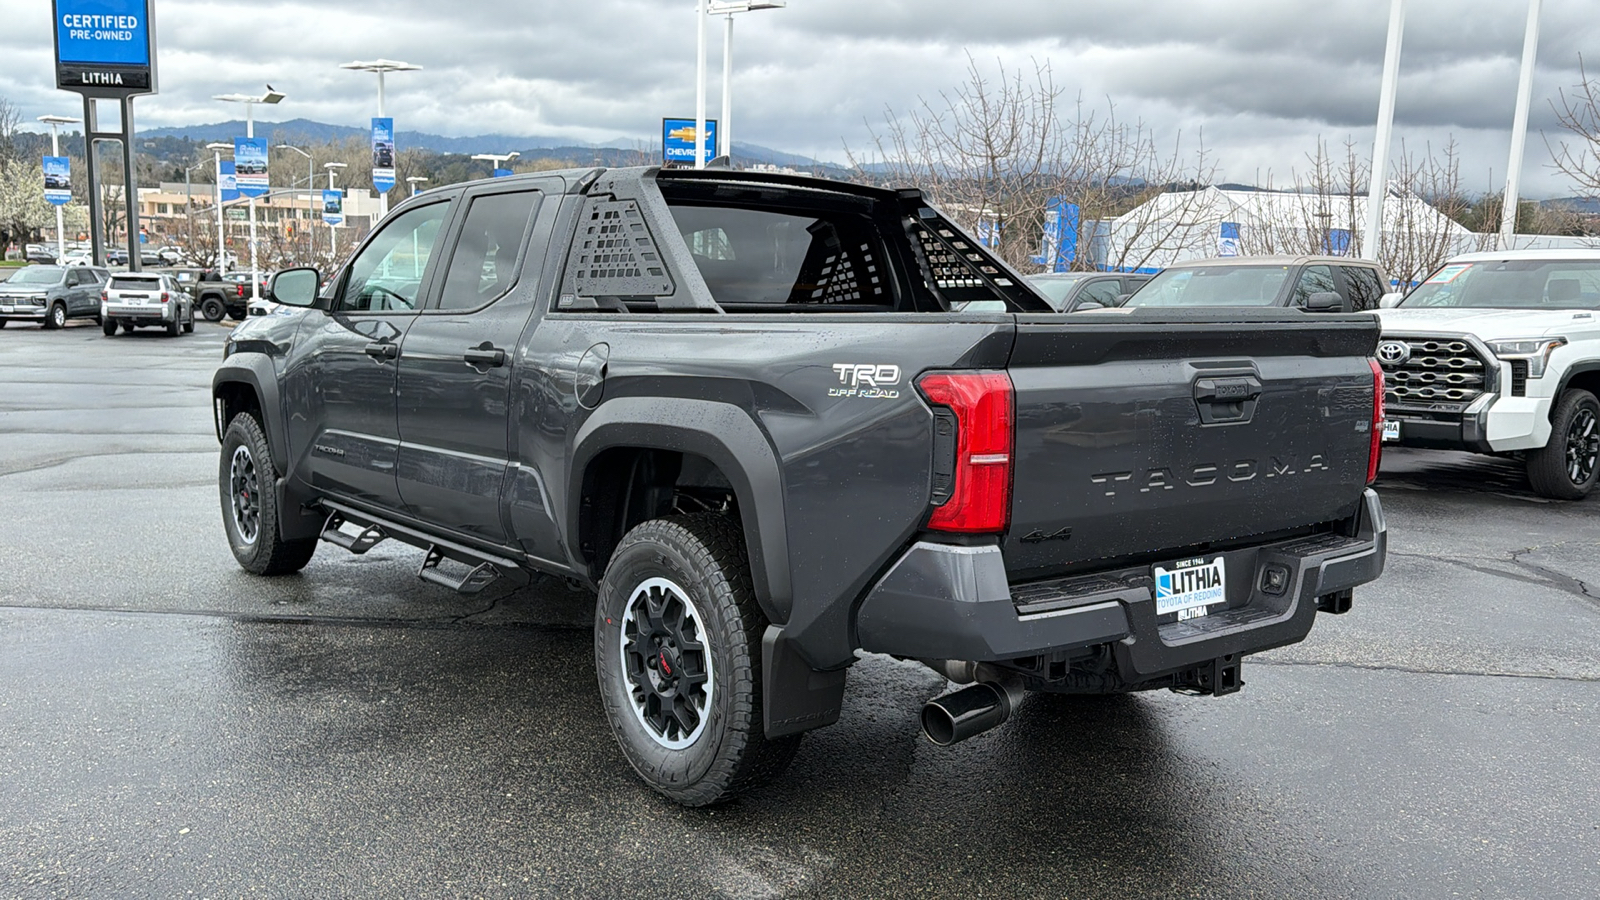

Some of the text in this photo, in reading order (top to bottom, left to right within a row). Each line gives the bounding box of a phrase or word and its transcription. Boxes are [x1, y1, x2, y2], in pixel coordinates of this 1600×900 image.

[63, 14, 137, 29] CERTIFIED
[70, 29, 132, 41] PRE-OWNED
[82, 71, 123, 85] LITHIA
[667, 148, 712, 157] CHEVROET
[833, 363, 901, 390] TRD
[828, 388, 899, 399] OFF ROAD
[1216, 385, 1247, 394] TOYOTA
[1090, 453, 1329, 496] TACOMA
[1176, 559, 1192, 568] SINCE
[1172, 566, 1221, 595] LITHIA
[1157, 588, 1222, 609] TOYOTA OF REDDING
[1186, 605, 1208, 619] LITHIA
